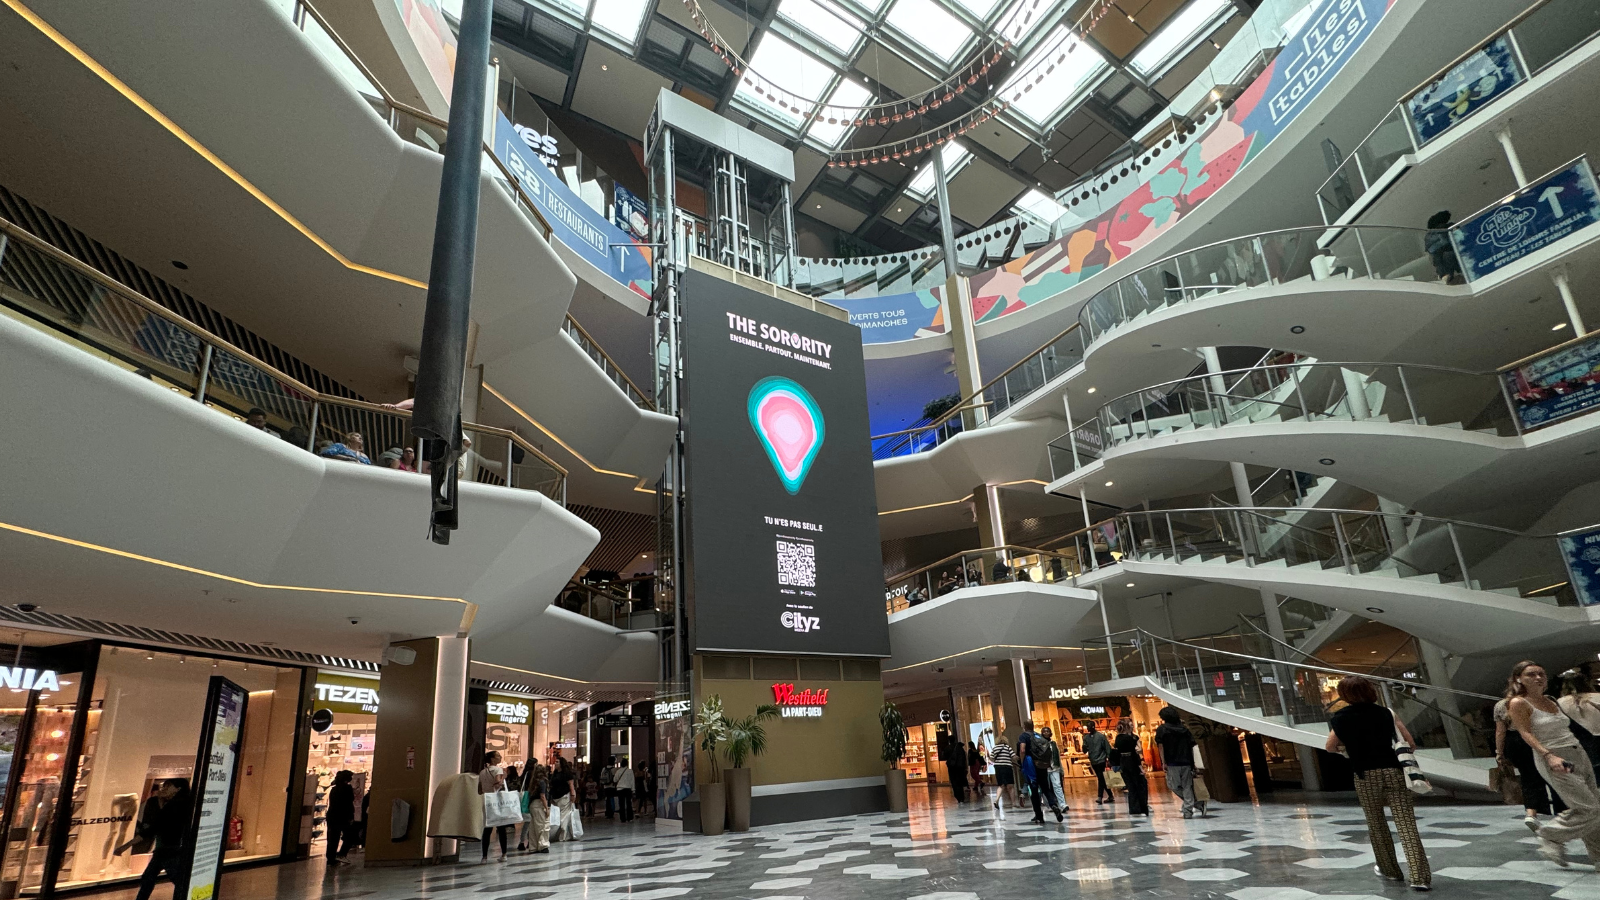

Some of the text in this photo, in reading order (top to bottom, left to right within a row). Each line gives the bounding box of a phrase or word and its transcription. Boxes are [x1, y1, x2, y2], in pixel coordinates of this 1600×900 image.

[1310, 0, 1352, 49] les
[1277, 17, 1360, 112] tables
[509, 152, 540, 196] 28
[548, 195, 604, 250] RESTAURANTS
[1478, 211, 1587, 268] CENTRE DE LOISIRS FAMILIAL
[849, 309, 905, 321] VERTS TOUS
[726, 311, 832, 359] THE SORORITY
[729, 333, 832, 370] ENSEMBLE. PARTOUT. MAINTENANT.
[764, 516, 823, 532] TU N'ES PAS SEUL.E
[1584, 534, 1600, 544] NIV
[781, 611, 820, 632] Cityz
[314, 683, 379, 705] TEZEN
[771, 683, 829, 705] Westfield
[362, 703, 379, 713] ling
[486, 701, 529, 717] EZENIS
[781, 706, 822, 718] LA PART-DIEU
[1080, 706, 1104, 714] WOMAN
[500, 714, 527, 724] lingerie
[598, 716, 605, 726] 0
[70, 815, 133, 827] CALZEDONIA
